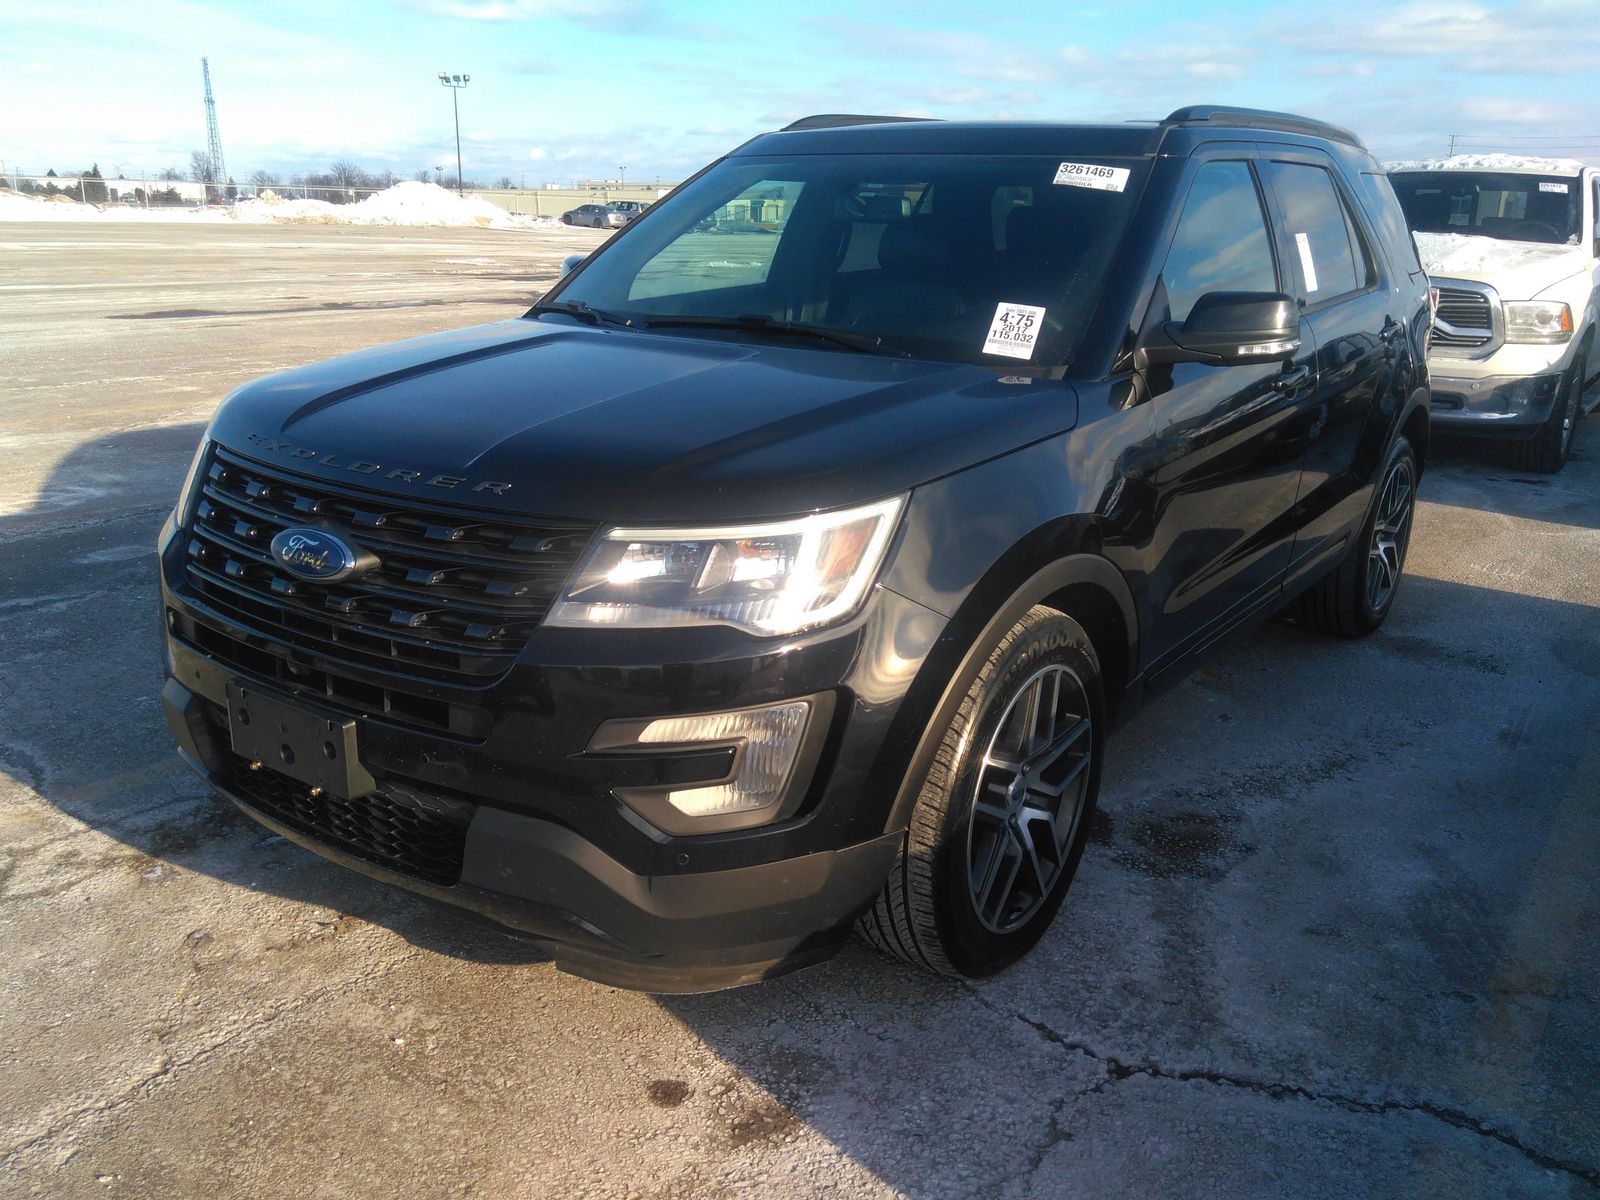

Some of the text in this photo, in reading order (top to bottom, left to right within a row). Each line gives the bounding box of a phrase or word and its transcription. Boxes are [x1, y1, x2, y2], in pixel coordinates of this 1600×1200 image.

[1060, 164, 1114, 178] 3261469
[999, 312, 1035, 327] 4:75
[1002, 324, 1028, 333] 2017
[246, 433, 512, 495] EXPLORER
[282, 535, 329, 570] Ford
